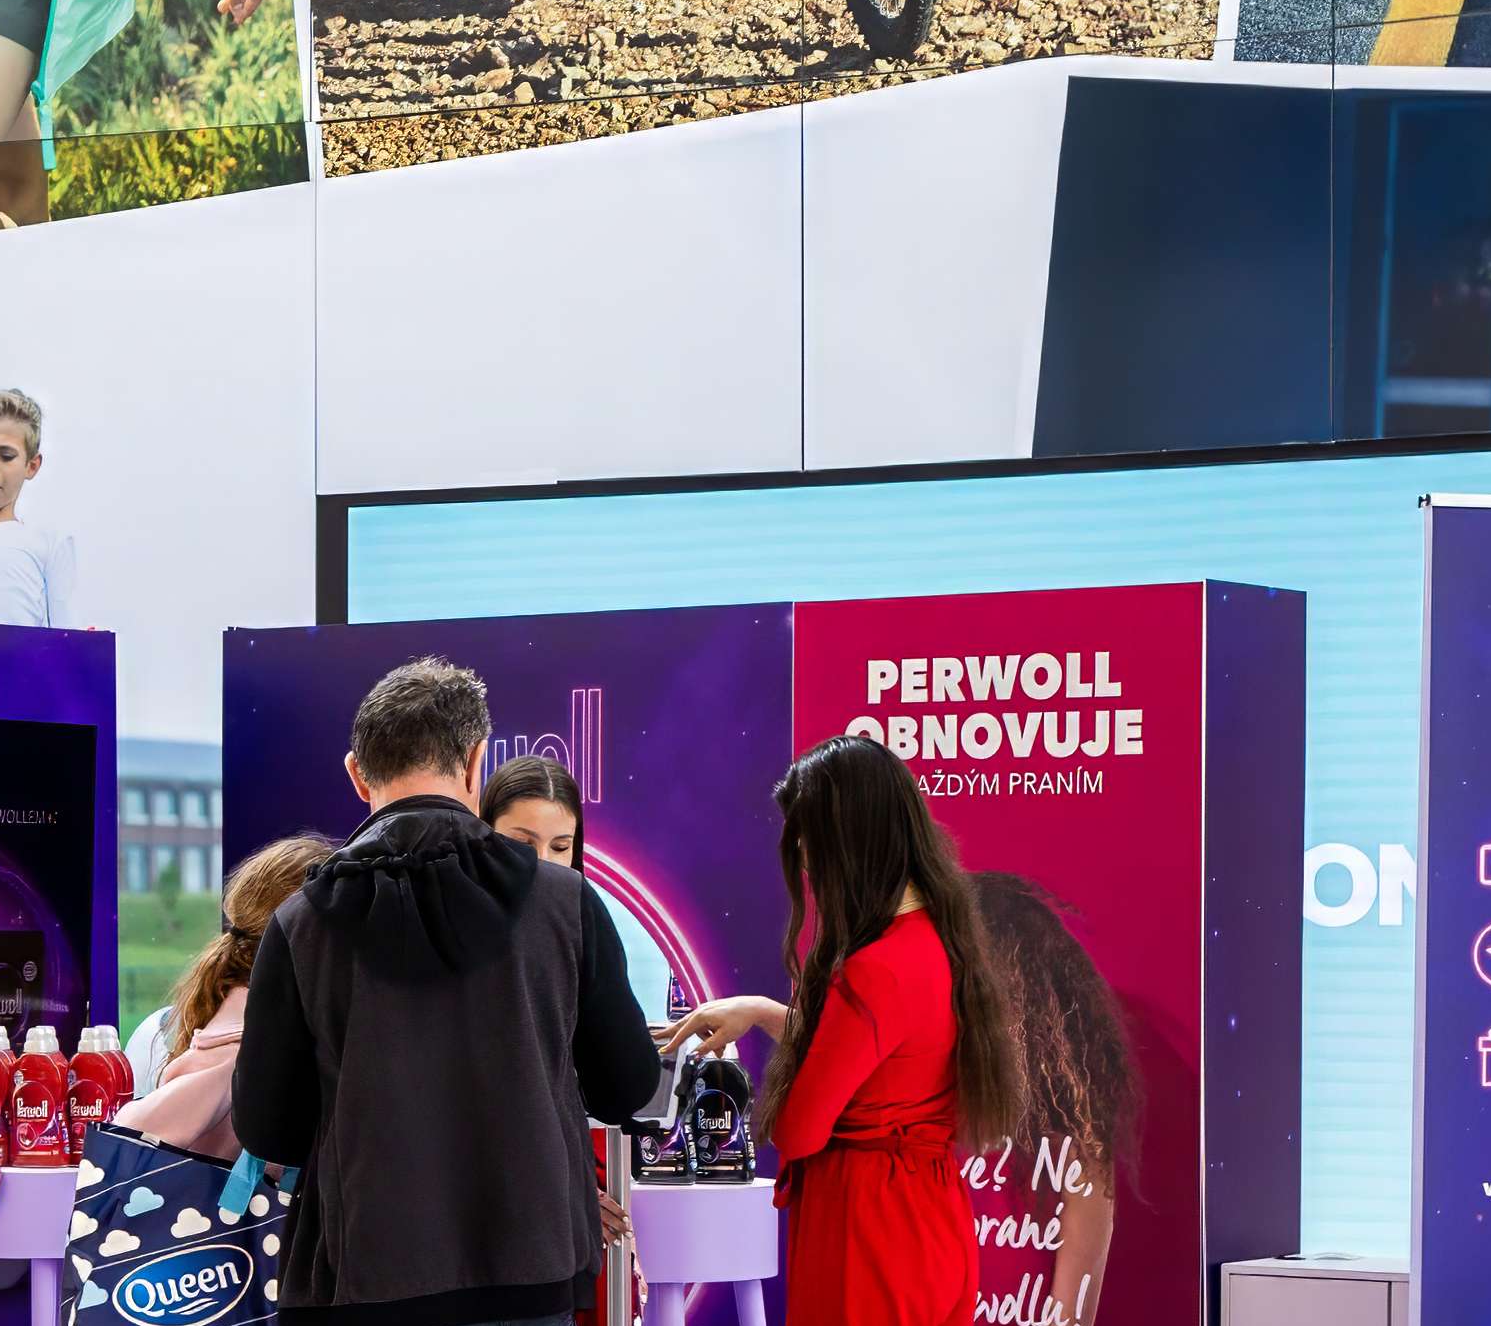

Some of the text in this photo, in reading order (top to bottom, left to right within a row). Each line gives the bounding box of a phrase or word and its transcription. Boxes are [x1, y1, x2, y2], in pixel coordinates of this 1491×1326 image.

[867, 651, 1122, 704] PERWOLL
[844, 709, 1144, 760] OBNOVUJE
[917, 766, 1103, 797] AŽDÝM PRANÍM
[16, 1098, 48, 1118] Perwoll
[697, 1108, 732, 1131] Perwoll
[1031, 1135, 1093, 1197] Ne,
[124, 1262, 242, 1318] Queen
